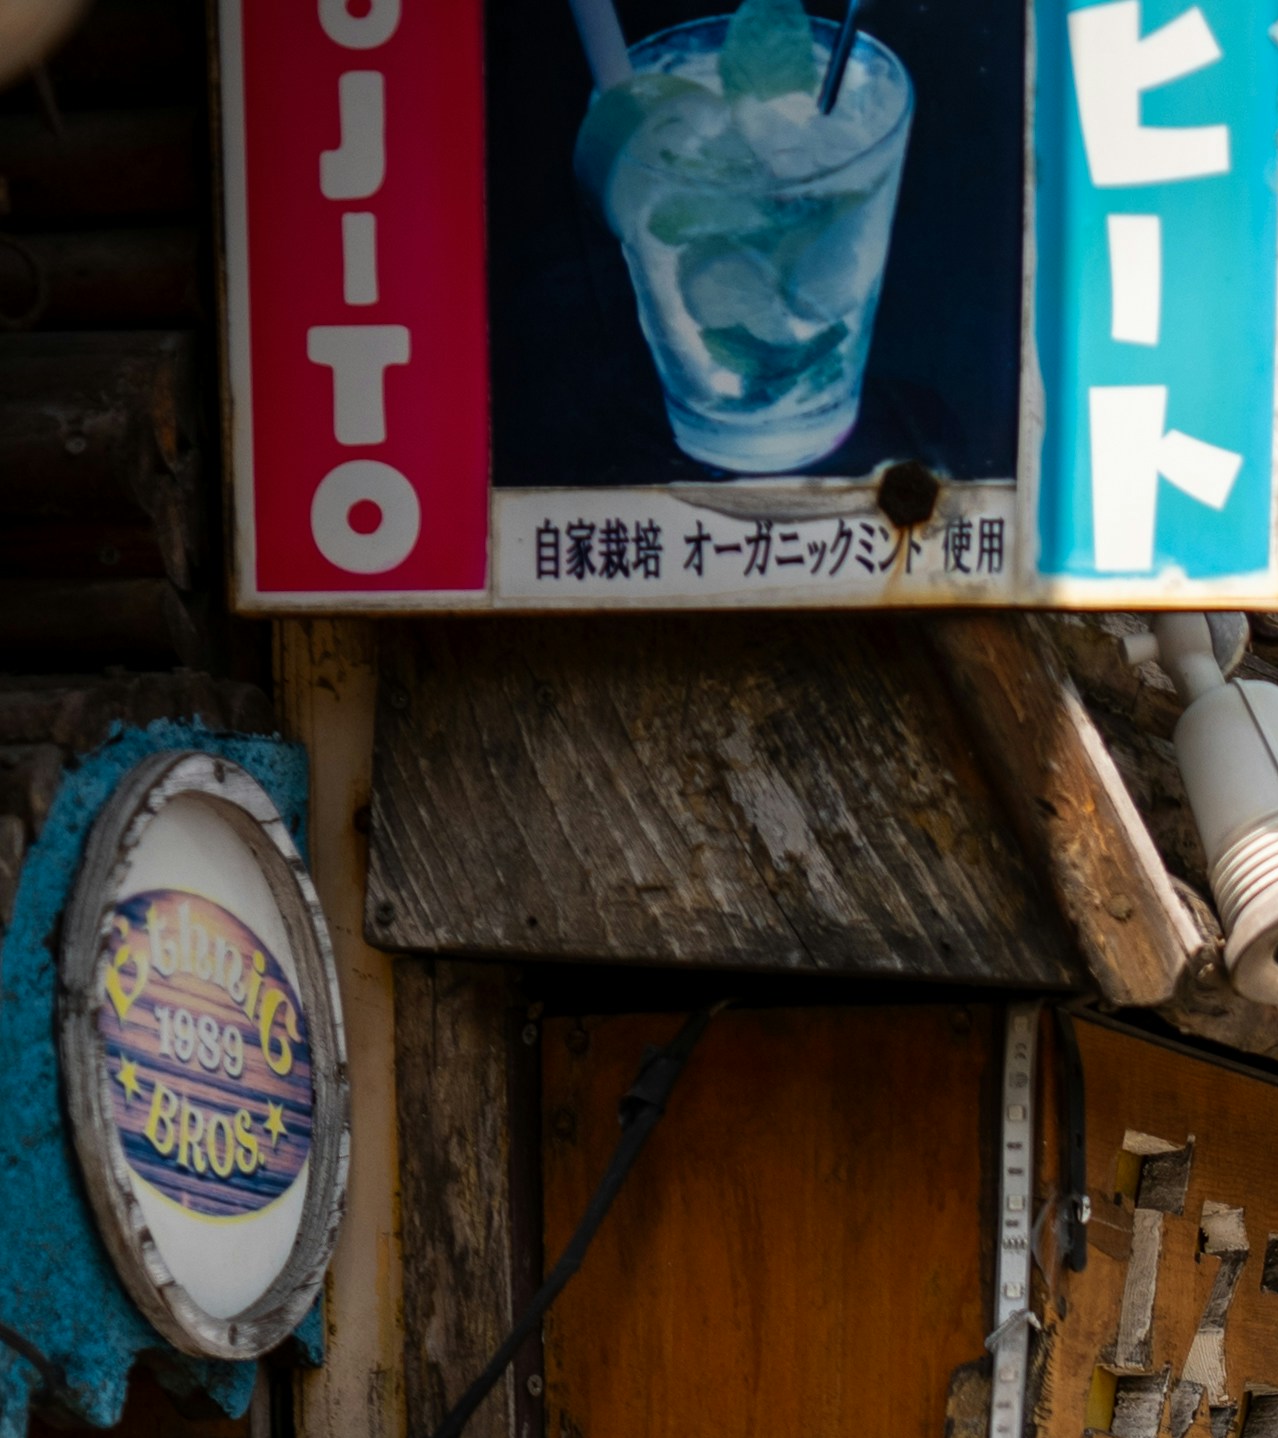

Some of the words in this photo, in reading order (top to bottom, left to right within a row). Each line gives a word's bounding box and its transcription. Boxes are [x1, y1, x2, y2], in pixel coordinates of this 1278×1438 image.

[535, 518, 662, 580] 自家栽培
[683, 519, 922, 576] オーガニックミント
[943, 517, 1006, 575] 使用
[154, 1006, 245, 1079] 1989
[144, 1080, 266, 1178] BROS.
